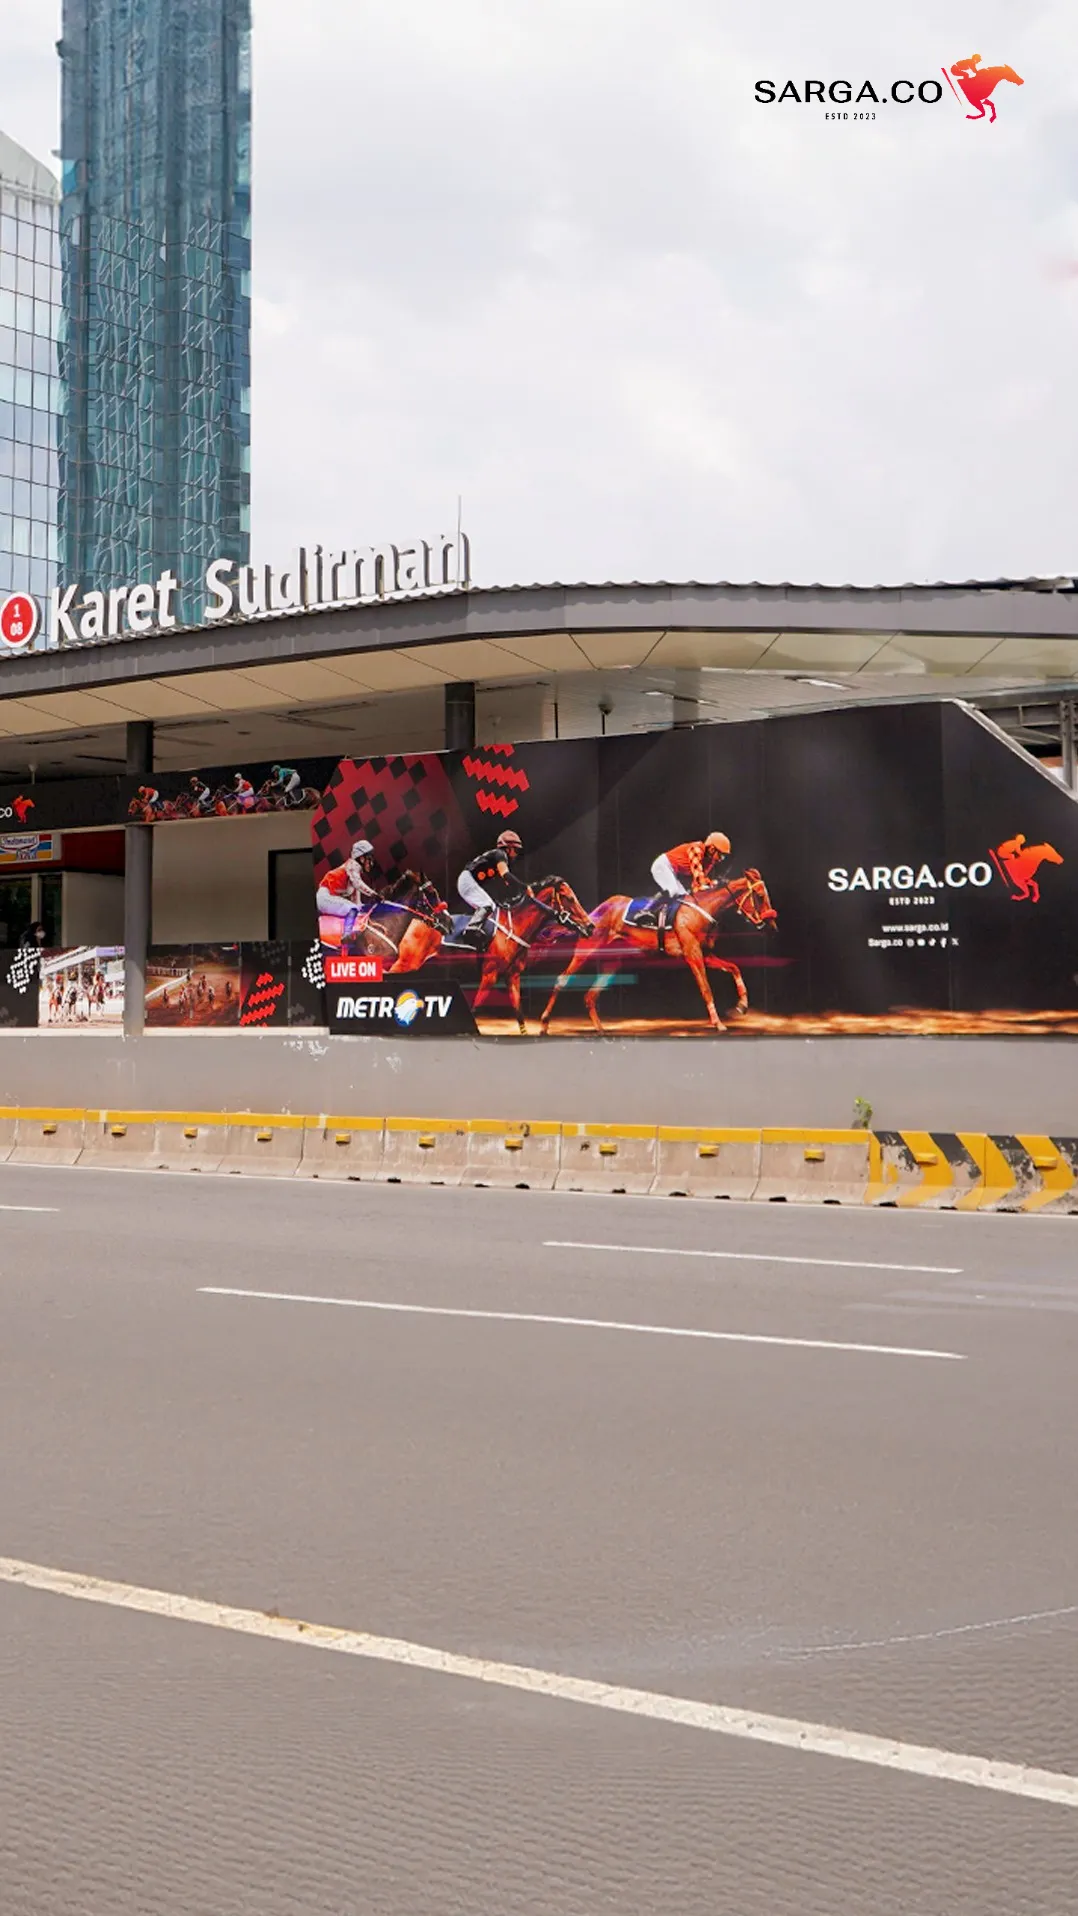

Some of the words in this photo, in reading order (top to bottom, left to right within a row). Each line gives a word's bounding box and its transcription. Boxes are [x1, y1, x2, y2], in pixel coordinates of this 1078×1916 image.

[51, 569, 178, 642] Karet
[204, 532, 470, 619] Sudirman
[13, 603, 21, 618] 1
[10, 622, 24, 636] 08
[828, 861, 993, 892] SARGA.CO
[889, 897, 911, 906] ESTD
[913, 896, 935, 905] 2023
[331, 962, 357, 978] LIVE
[358, 962, 377, 977] ON
[425, 996, 453, 1018] TV
